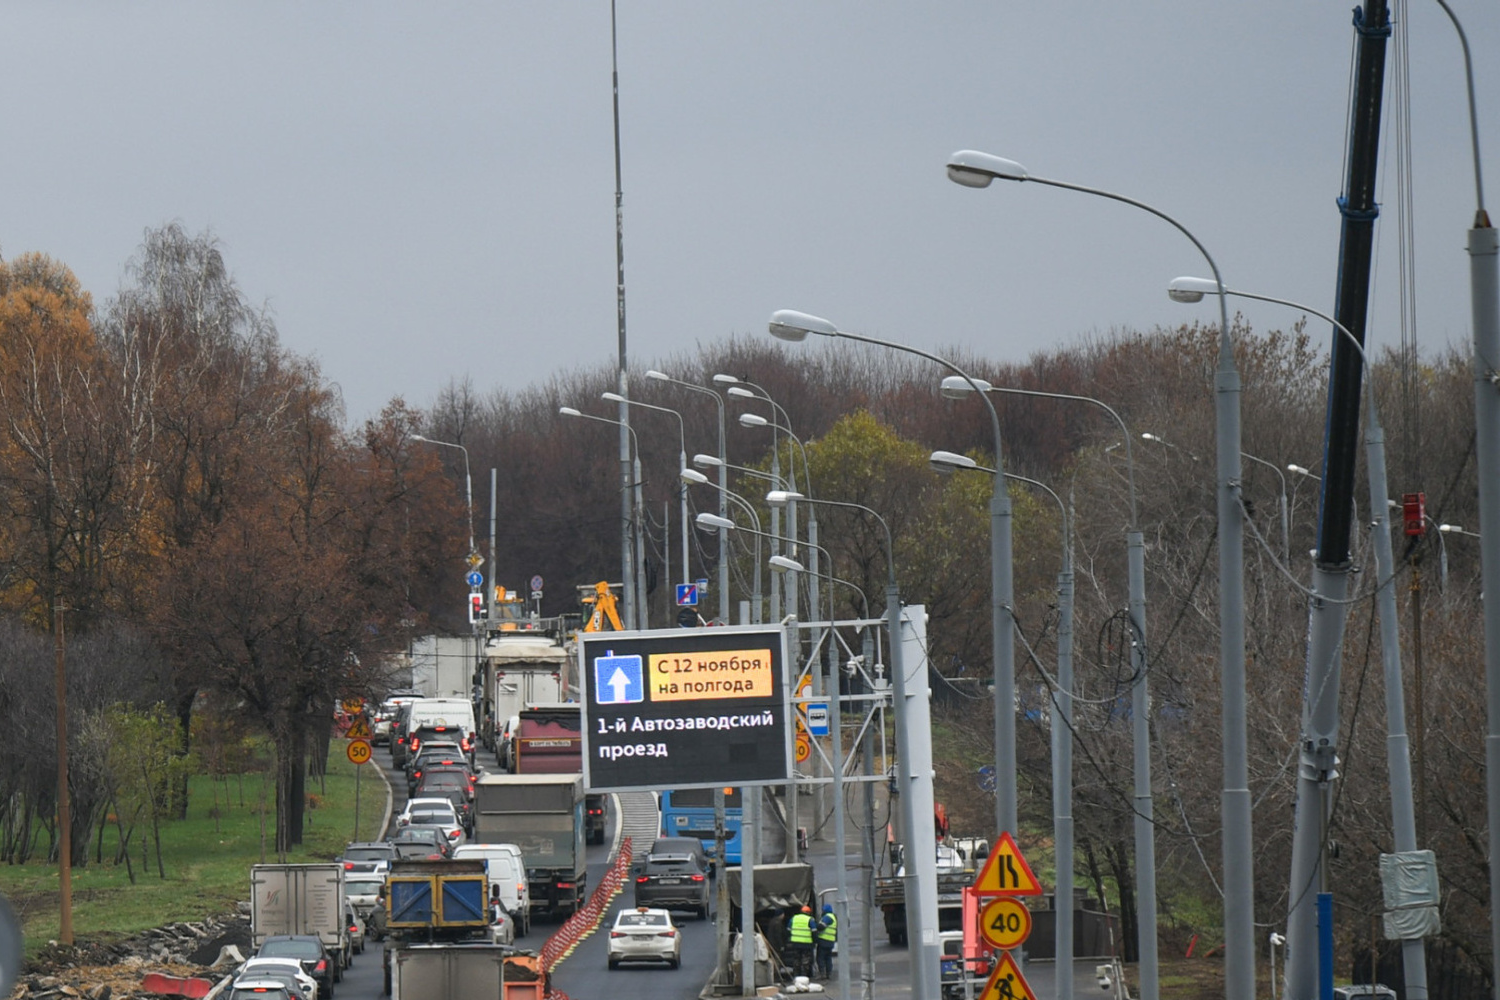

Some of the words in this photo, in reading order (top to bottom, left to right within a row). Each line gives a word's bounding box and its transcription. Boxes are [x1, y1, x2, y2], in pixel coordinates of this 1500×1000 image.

[658, 660, 668, 673] С
[674, 659, 692, 672] 12
[698, 657, 761, 673] ноября
[659, 682, 679, 693] на
[683, 680, 753, 692] полгода
[598, 718, 627, 733] 1-й
[631, 711, 773, 732] Автозаводский
[353, 747, 366, 757] 50
[599, 743, 668, 761] проезд
[991, 913, 1020, 933] 40
